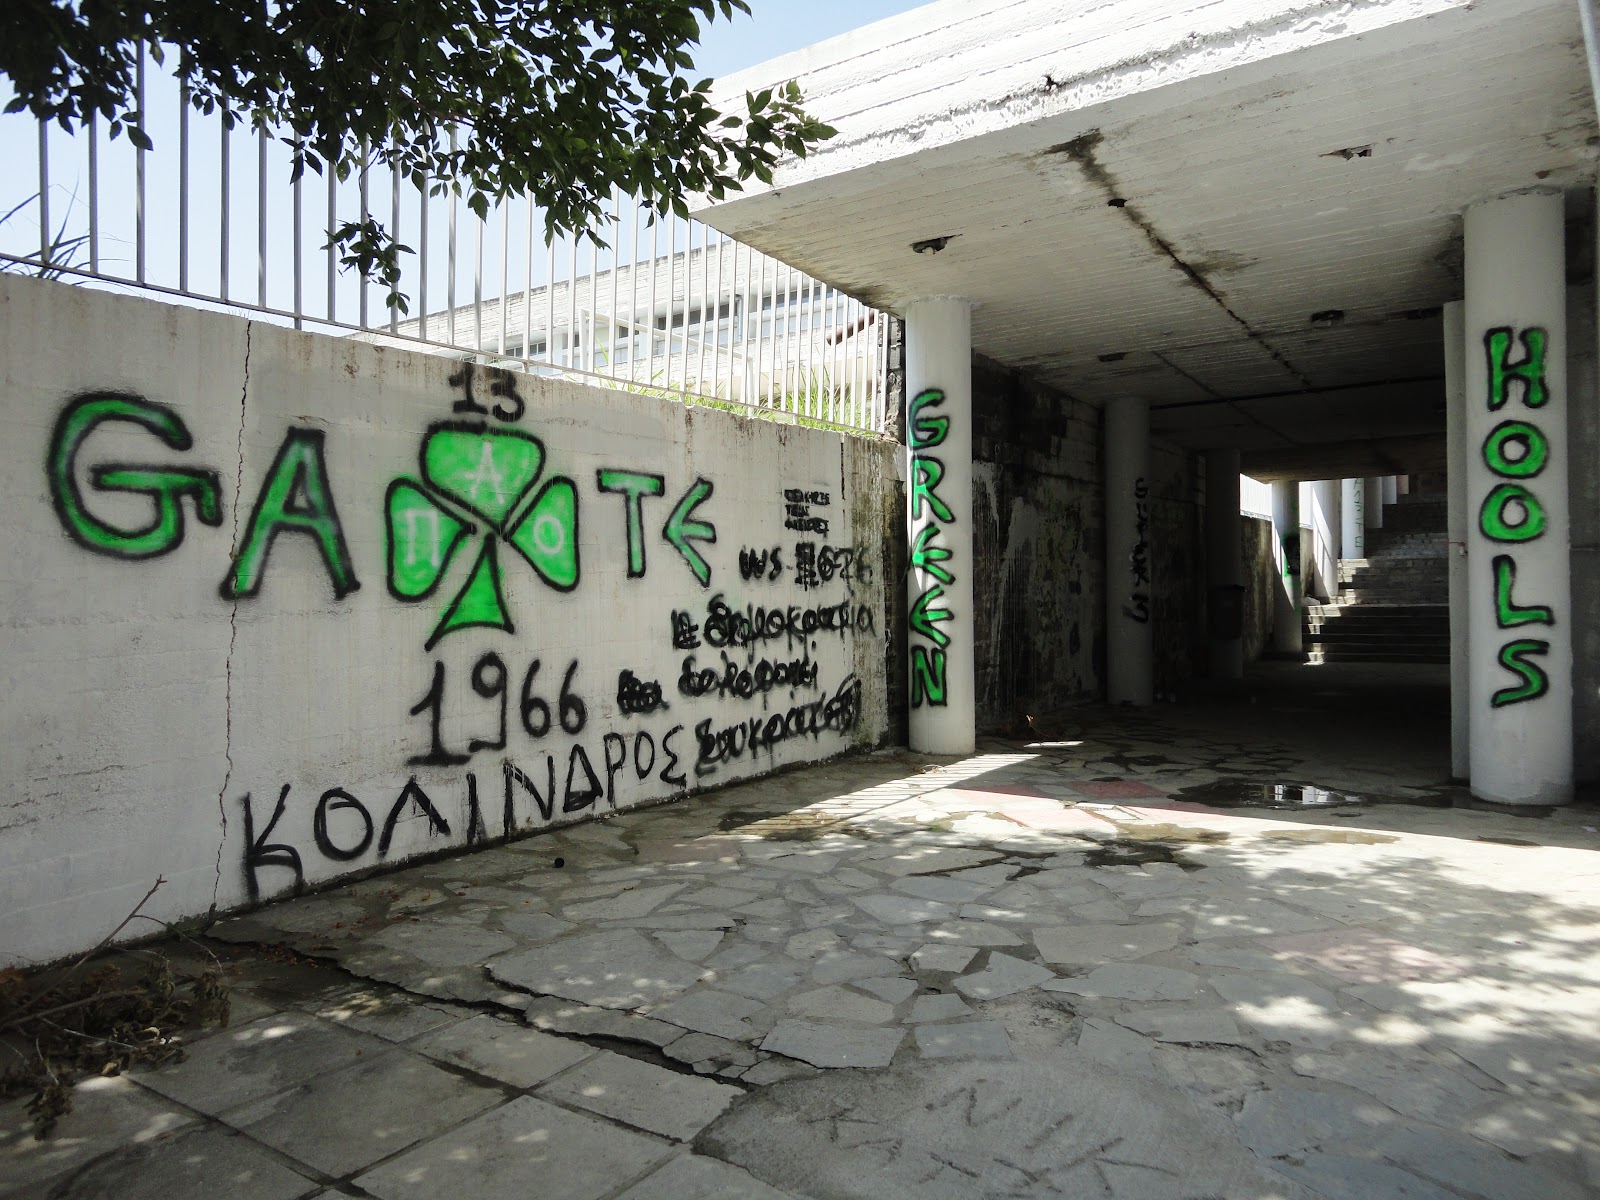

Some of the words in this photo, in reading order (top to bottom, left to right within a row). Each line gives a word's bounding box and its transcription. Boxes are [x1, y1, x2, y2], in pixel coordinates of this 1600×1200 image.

[449, 363, 525, 422] 13
[907, 388, 957, 708] GREEN
[1480, 326, 1555, 708] HOOLS
[403, 652, 591, 767] 1966
